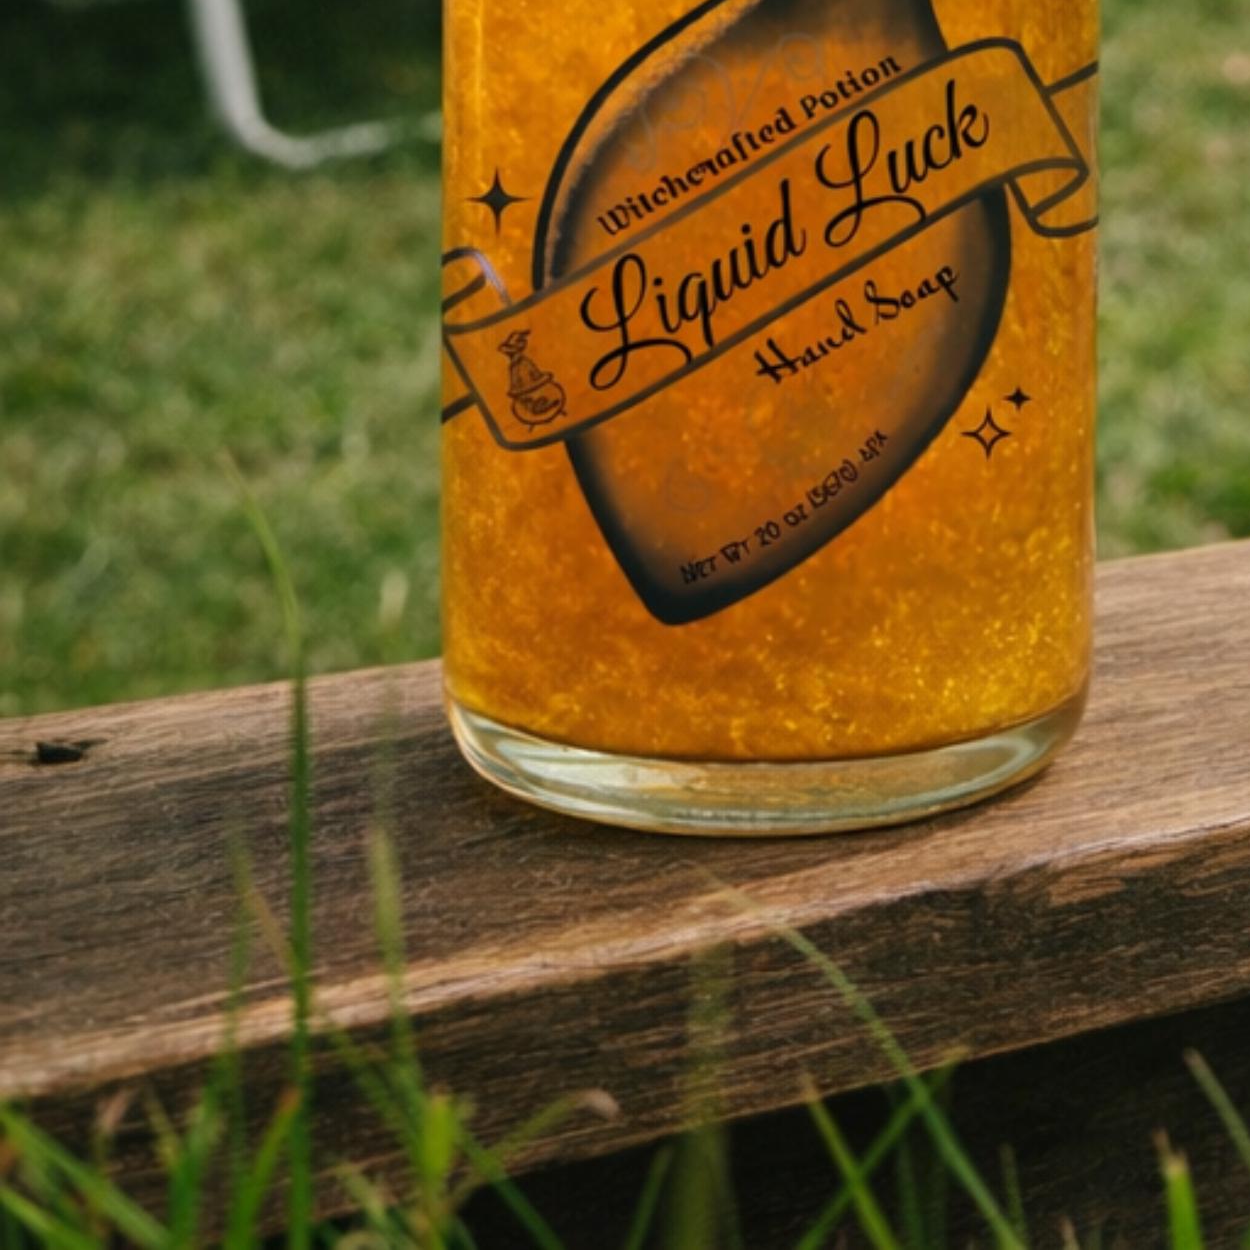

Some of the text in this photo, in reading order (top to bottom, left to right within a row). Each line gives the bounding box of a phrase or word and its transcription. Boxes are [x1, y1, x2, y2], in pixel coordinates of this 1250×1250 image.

[598, 55, 903, 237] Witchcrafted Potion
[580, 80, 989, 390] Liquid Luck
[754, 266, 959, 383] Hand Soap
[753, 520, 782, 547] 20
